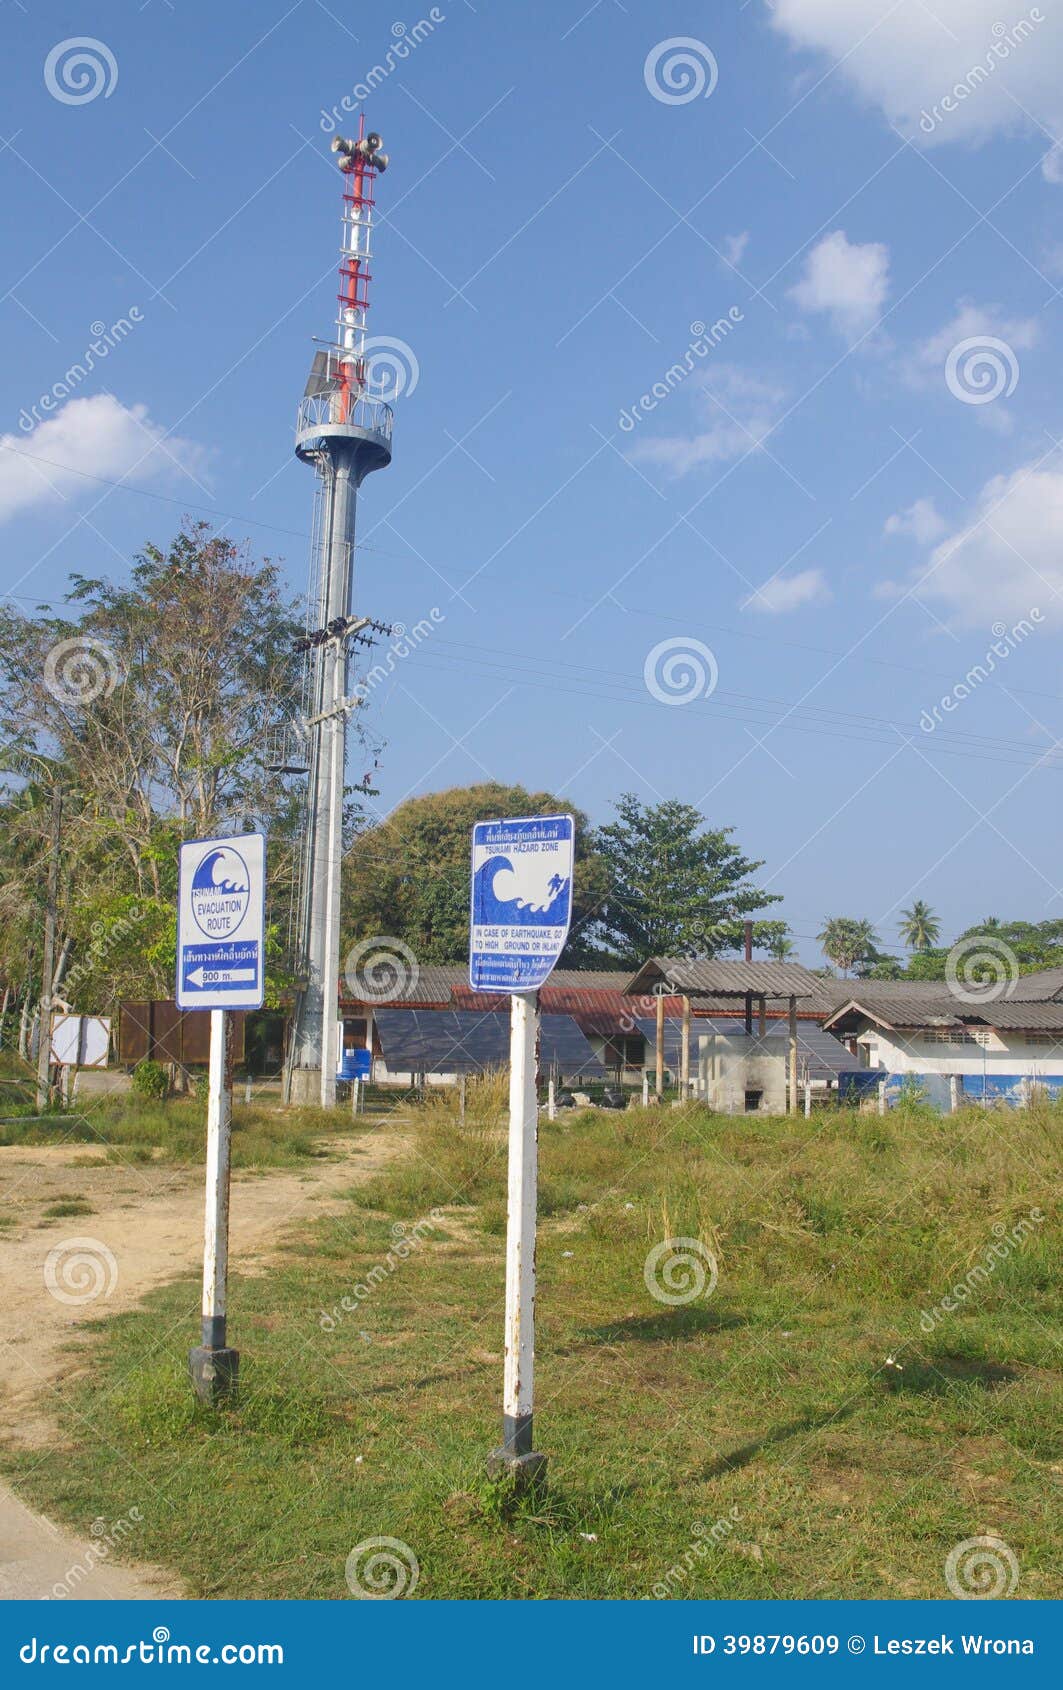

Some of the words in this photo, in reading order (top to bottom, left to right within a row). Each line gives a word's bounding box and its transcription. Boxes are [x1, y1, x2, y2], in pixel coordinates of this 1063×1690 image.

[485, 845, 511, 855] TSUNAMI
[513, 844, 539, 854] HAZARD
[541, 842, 559, 852] ZONE
[192, 886, 223, 898] TSUNAMI
[197, 900, 241, 915] EVACUATION
[207, 917, 231, 930] ROUTE
[476, 928, 482, 937] IN
[483, 928, 499, 937] CASE
[501, 929, 509, 937] OF
[475, 941, 483, 949] TO
[485, 941, 499, 949] HIGH
[504, 941, 530, 951] GROUND
[532, 942, 540, 951] OR
[202, 972, 219, 981] 900
